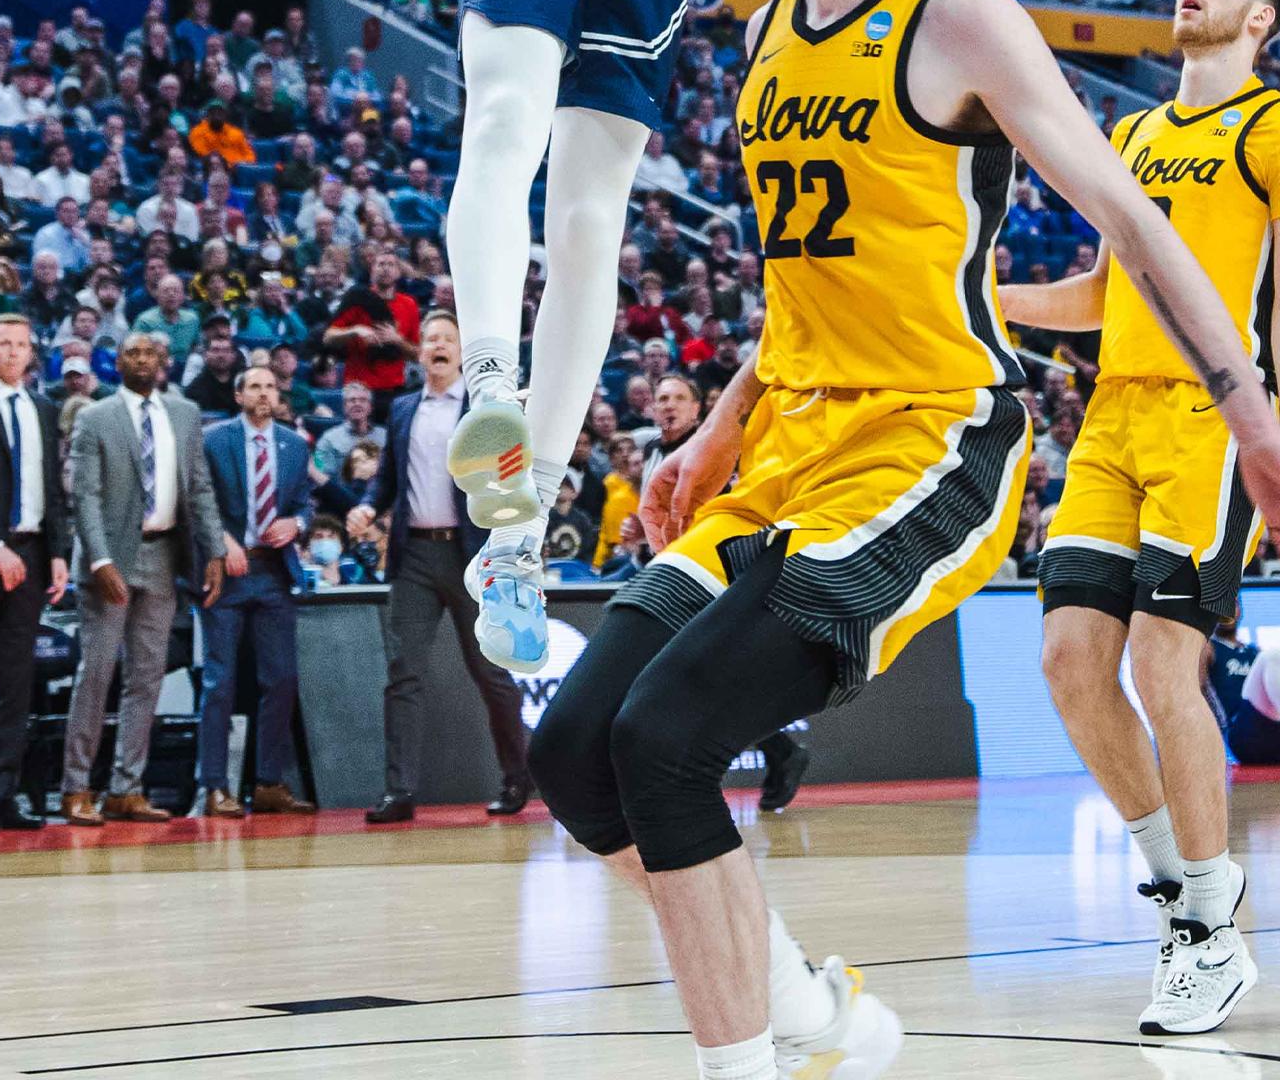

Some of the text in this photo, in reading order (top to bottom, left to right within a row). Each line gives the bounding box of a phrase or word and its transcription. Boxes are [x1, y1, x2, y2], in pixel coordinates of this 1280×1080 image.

[741, 76, 880, 147] Iowa
[1131, 146, 1227, 186] Iowa
[756, 160, 856, 259] 22
